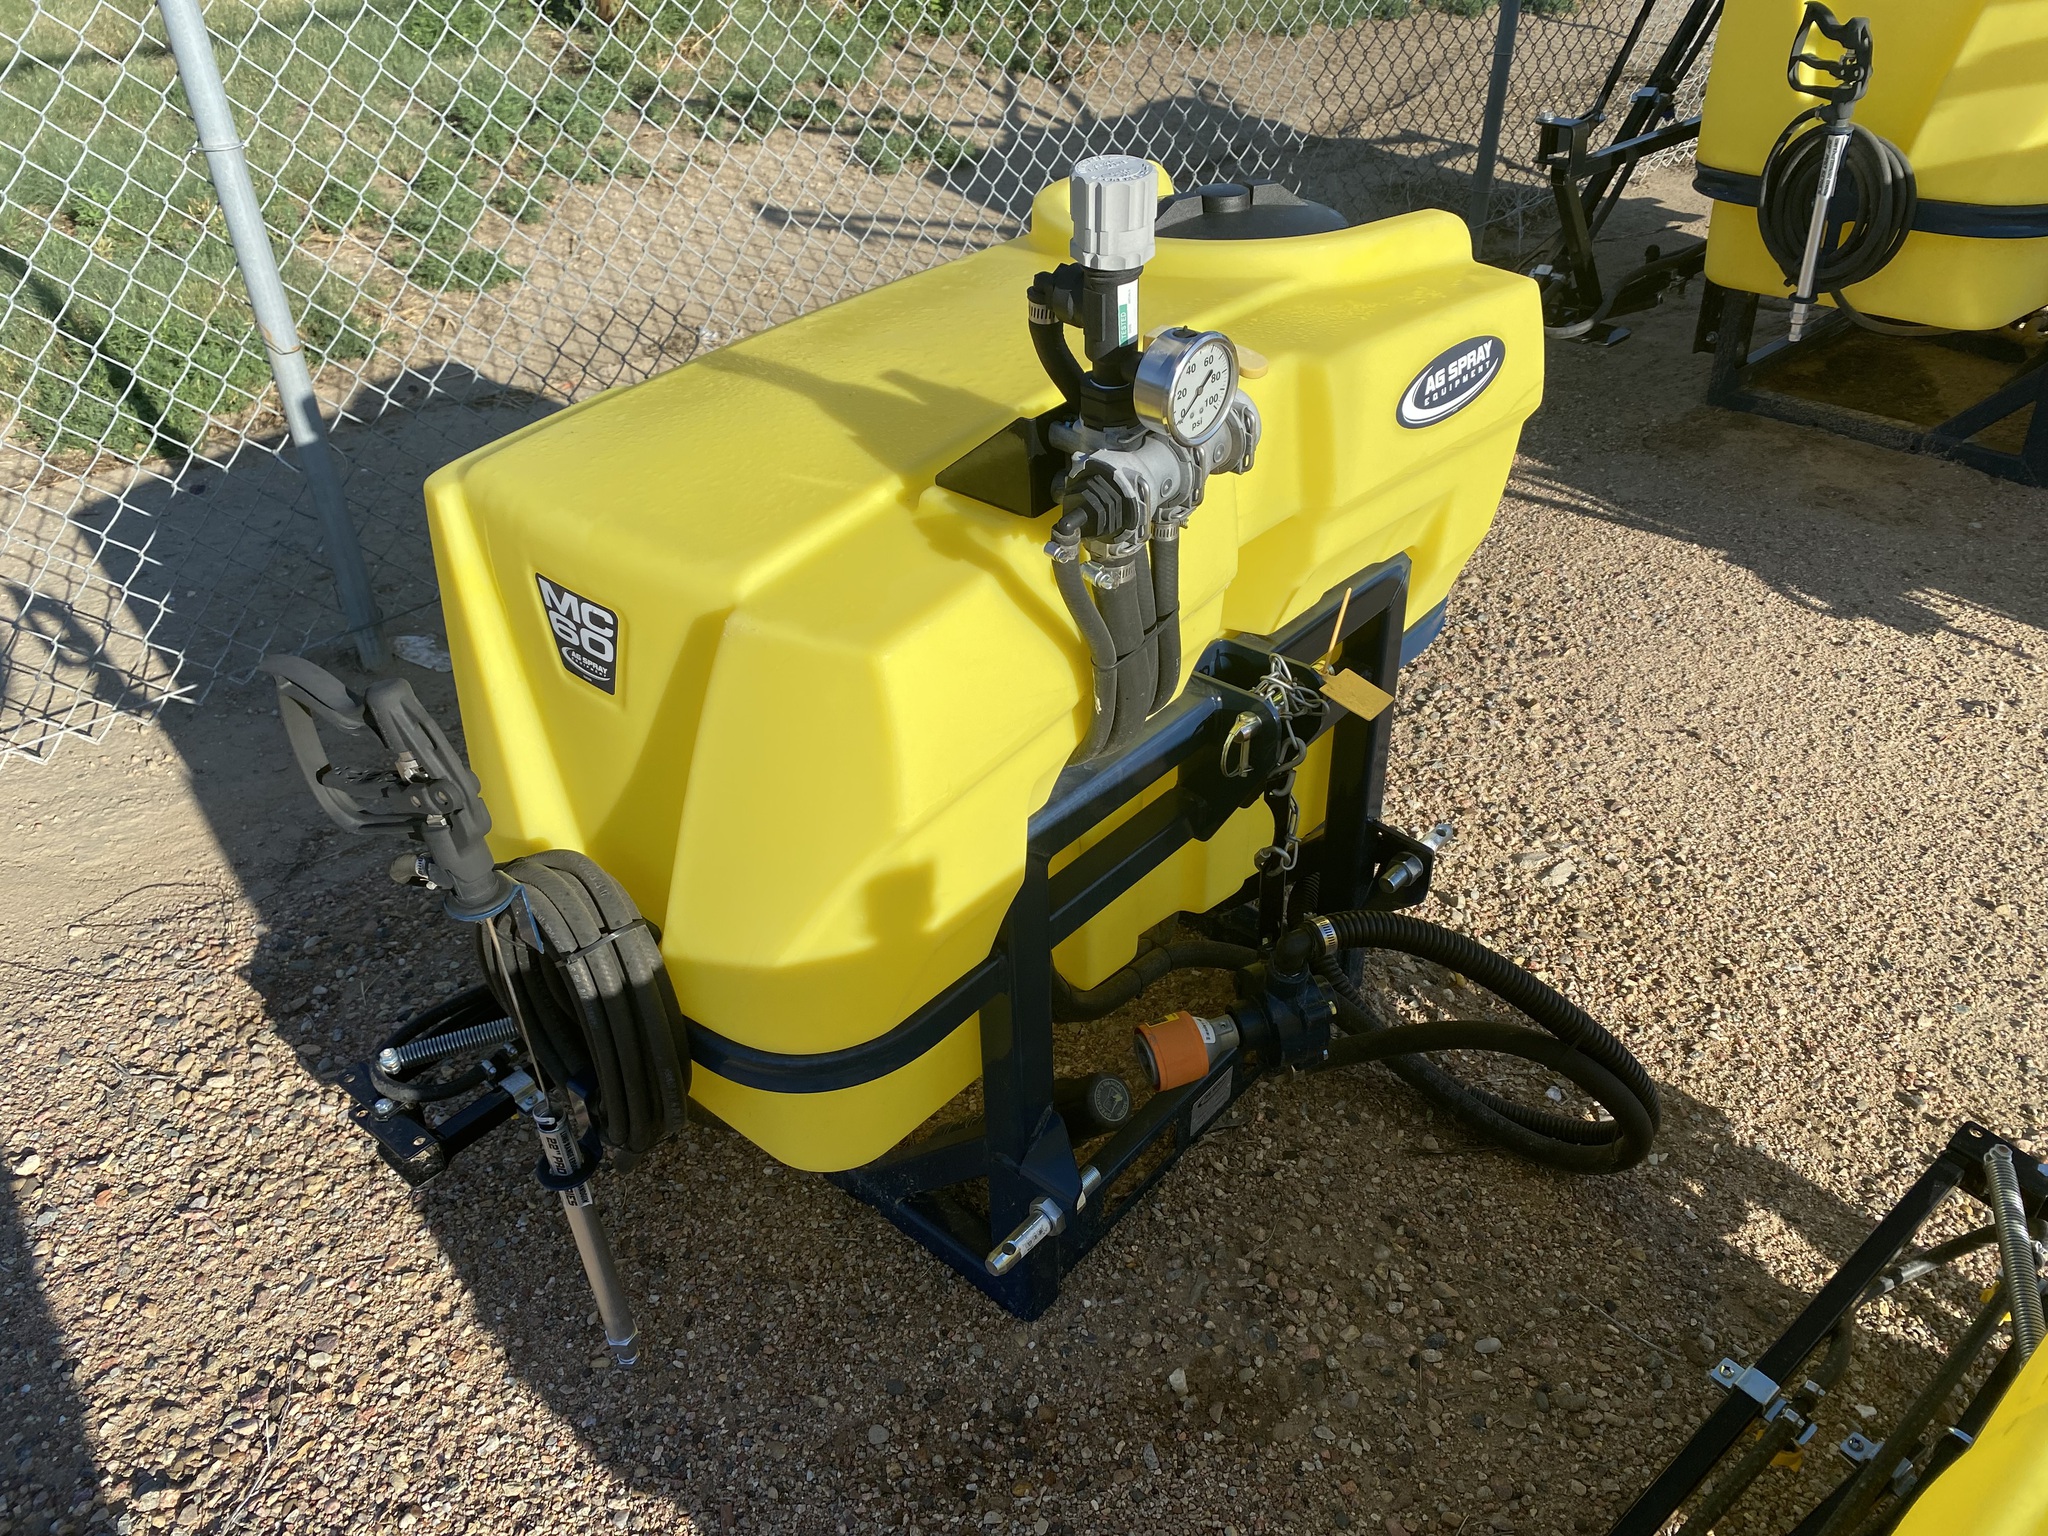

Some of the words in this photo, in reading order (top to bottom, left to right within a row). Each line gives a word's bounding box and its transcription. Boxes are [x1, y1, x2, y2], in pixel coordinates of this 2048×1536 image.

[1185, 363, 1197, 375] 40
[1203, 354, 1214, 367] 60
[1424, 367, 1446, 396] AG
[1447, 339, 1493, 382] SPRAY
[1210, 371, 1221, 384] 80
[1424, 360, 1491, 407] EQUIPMENT
[1176, 387, 1188, 401] 20
[1204, 393, 1219, 407] 100
[1180, 408, 1186, 419] 0
[1191, 416, 1203, 431] psi
[538, 577, 614, 639] MC
[548, 610, 614, 663] 60
[571, 650, 582, 662] AG
[582, 655, 608, 675] SPRAY
[546, 1136, 561, 1157] 22"
[553, 1155, 567, 1175] PRO
